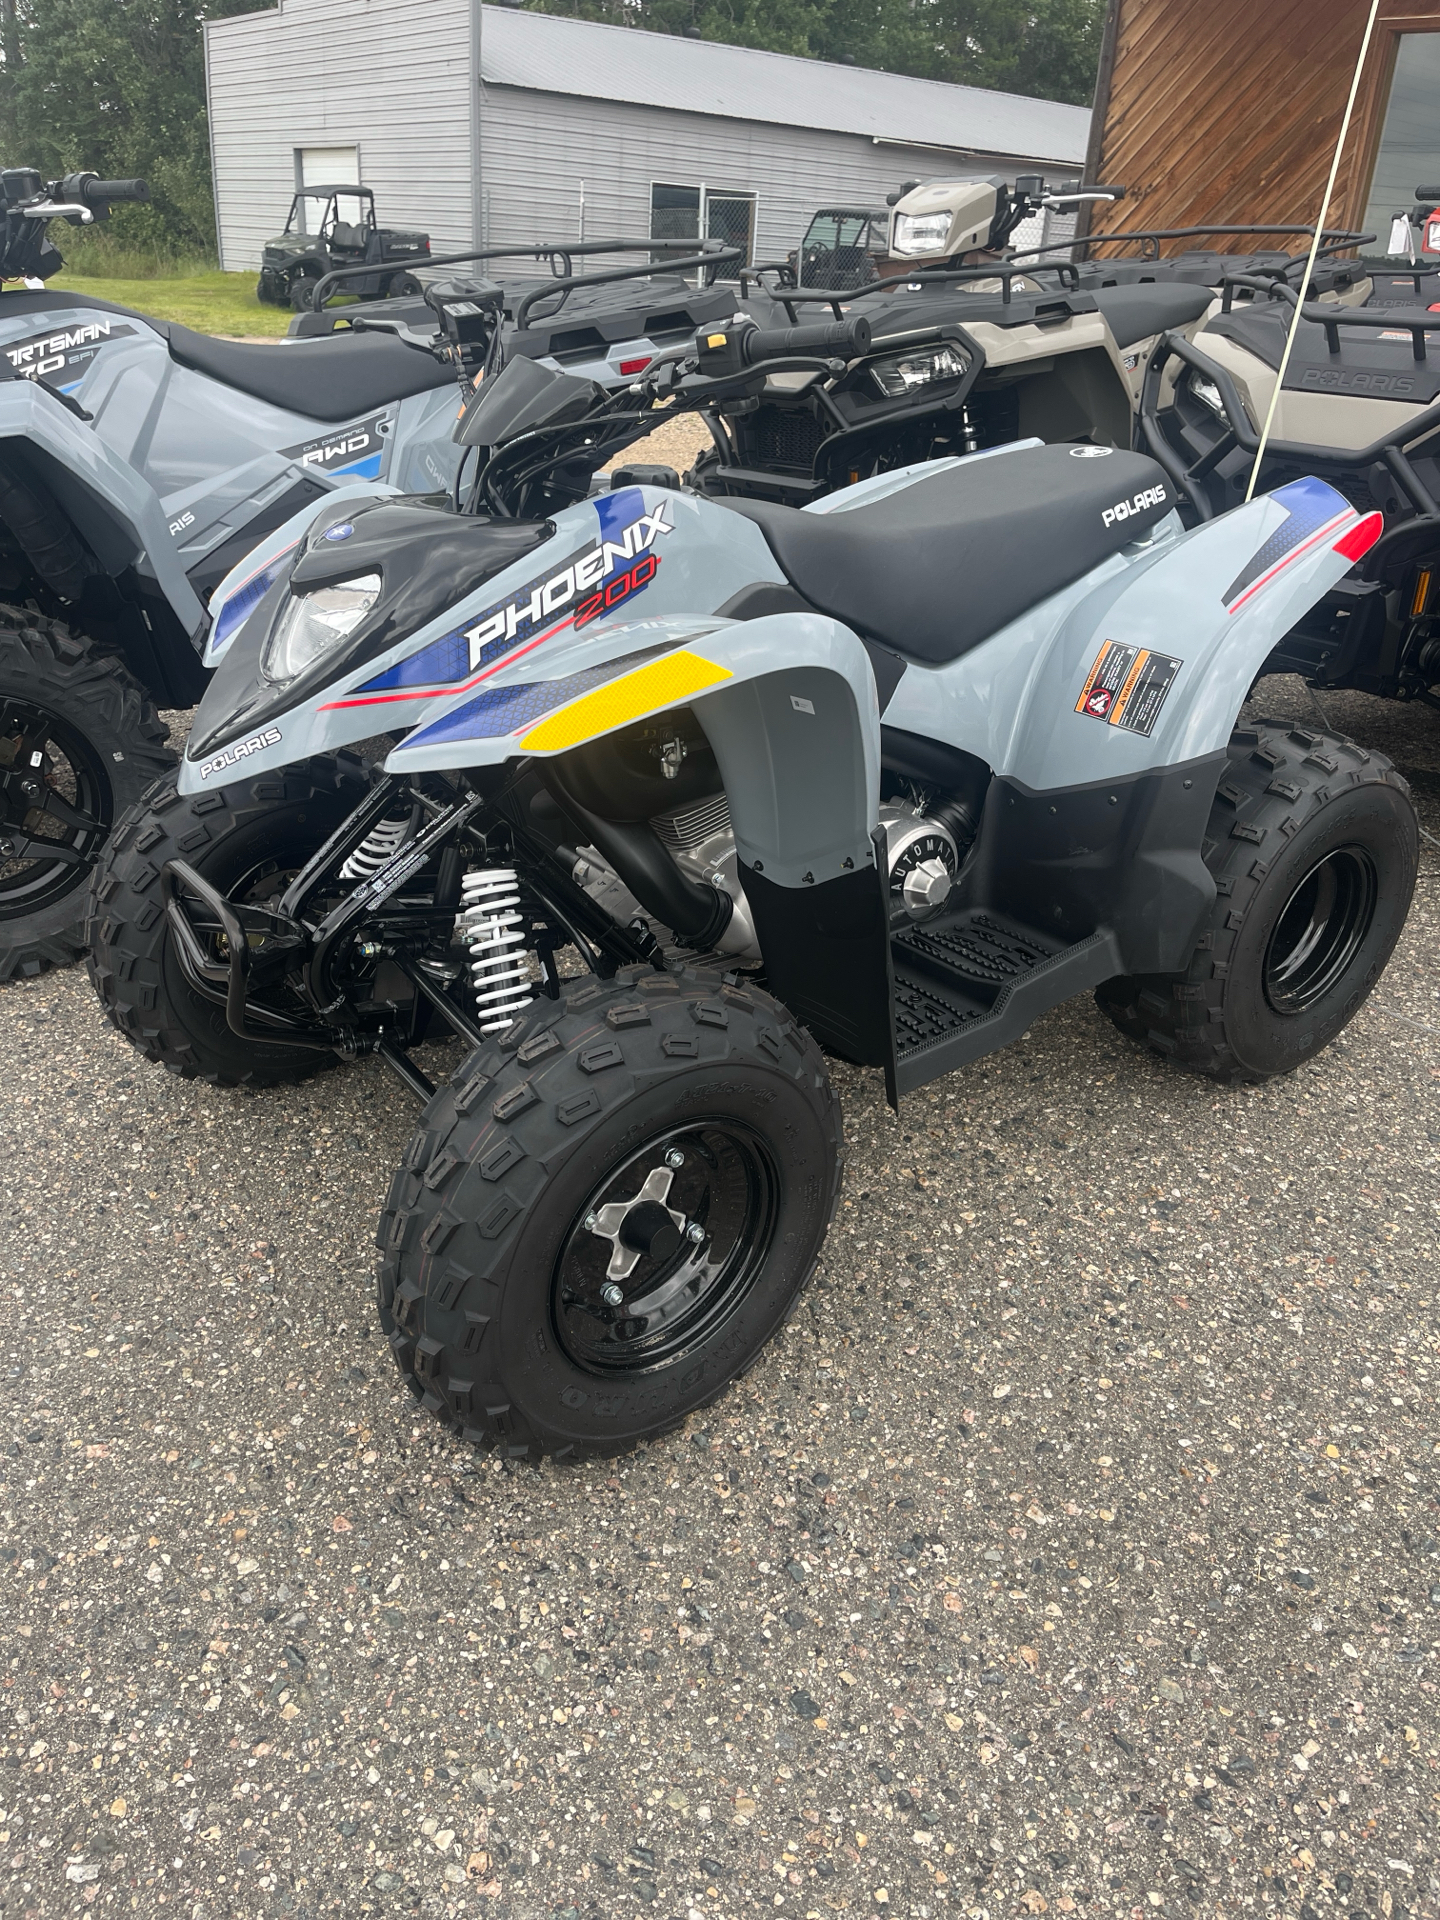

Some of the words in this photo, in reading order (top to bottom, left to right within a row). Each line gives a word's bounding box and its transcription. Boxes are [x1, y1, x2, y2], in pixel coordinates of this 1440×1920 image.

[68, 350, 95, 365] EFI
[1301, 368, 1416, 394] POLARIS
[302, 443, 318, 452] ON
[321, 427, 365, 447] DEMAND
[302, 433, 370, 468] AWD
[1101, 484, 1167, 529] POLARIS
[464, 499, 676, 673] PHOENIX
[573, 553, 660, 631] 200
[1087, 657, 1104, 690] WARNING
[1122, 667, 1141, 701] WARNING
[200, 727, 282, 780] POLARIS
